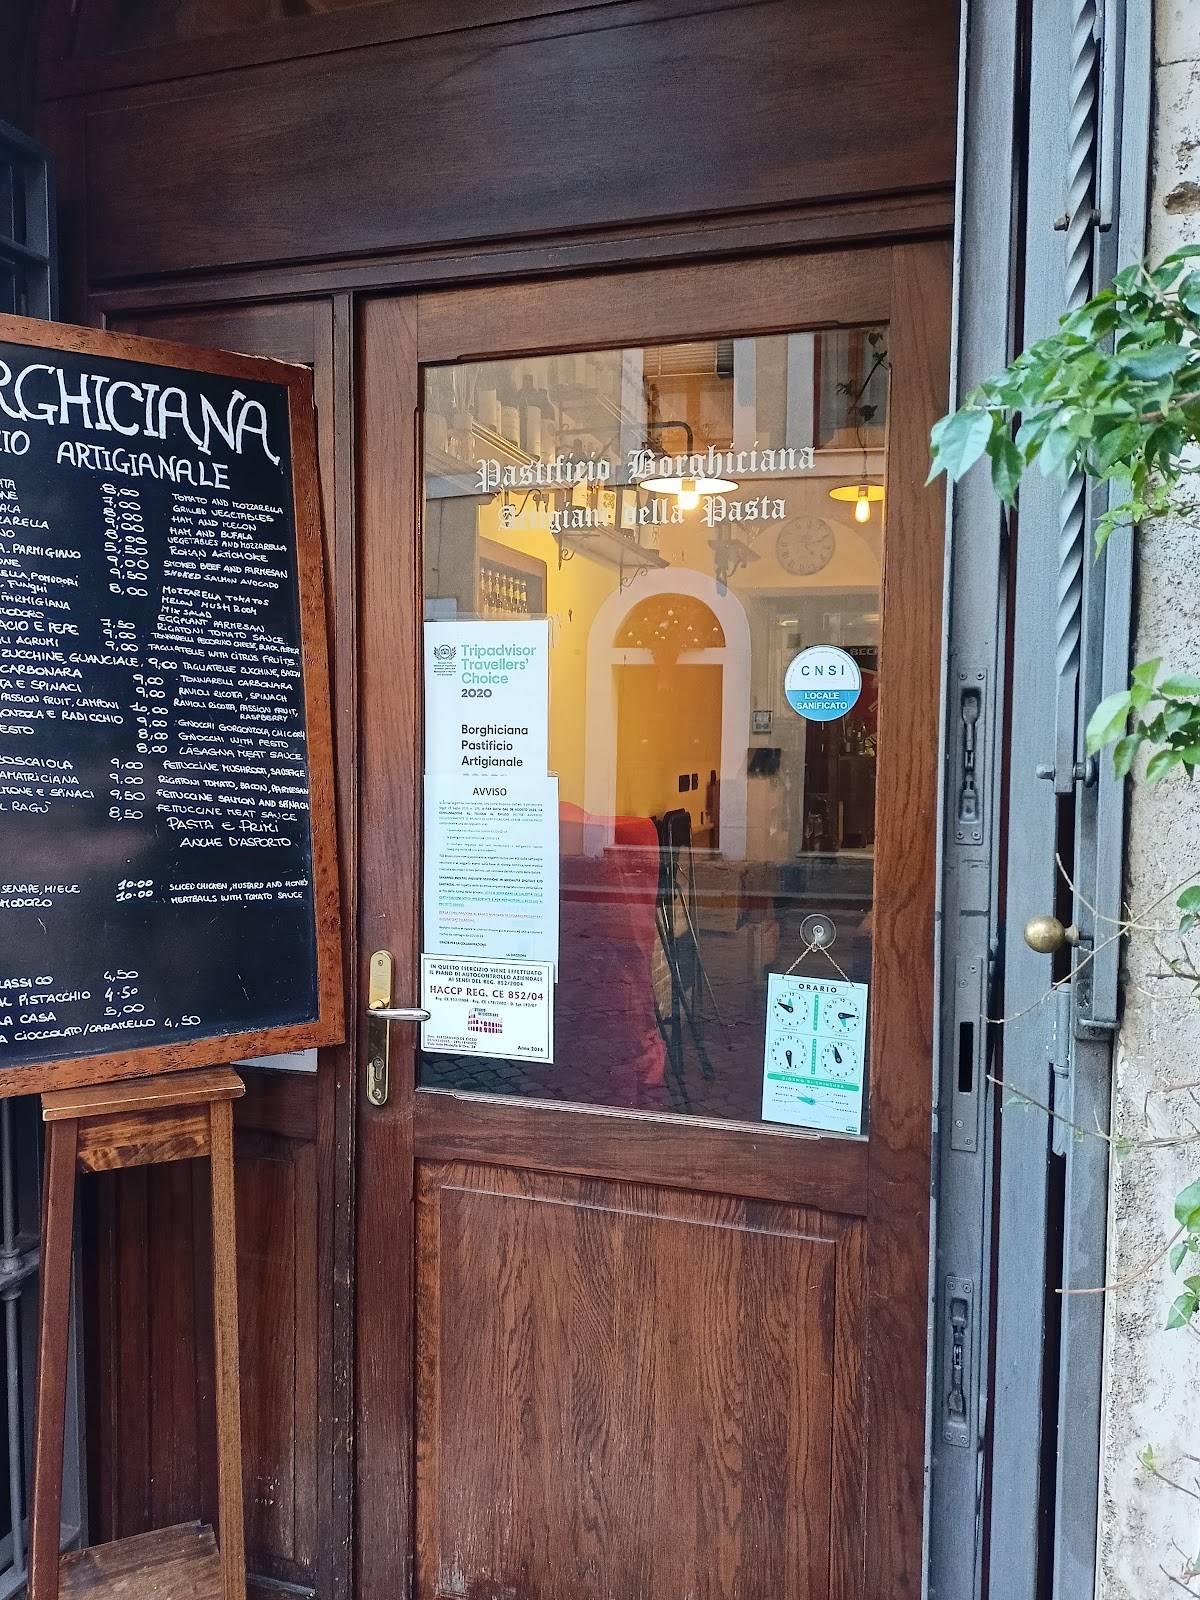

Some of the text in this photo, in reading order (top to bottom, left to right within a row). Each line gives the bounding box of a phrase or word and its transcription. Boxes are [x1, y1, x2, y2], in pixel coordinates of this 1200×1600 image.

[0, 430, 230, 490] IO ARTIGIANALE
[474, 441, 816, 493] Pastificio Borghiciana
[172, 493, 283, 514] TOMATO AND MOZZARELLA
[173, 505, 274, 522] GRILLED VEGETABLES
[702, 495, 787, 528] Pasta
[171, 516, 257, 531] HAM AND MELON
[169, 527, 253, 540] HAM AND BUFALA
[13, 543, 81, 559] PARMIGIANO
[168, 537, 287, 552] VEGETABLES AND MOZZARELLA
[212, 550, 269, 562] ARTICHOKE
[163, 560, 288, 579] SMOKED BEEF AND PARMESAN
[31, 572, 79, 587] POMODORI
[163, 570, 279, 589] SMOKED SALMON AVOCADO
[161, 596, 193, 607] MELON
[162, 585, 270, 607] MOZZARELLA TOMATOS
[161, 605, 212, 620] MIX SALAD
[34, 621, 79, 636] E PEPE
[157, 614, 265, 634] EGGPLANT PARMESAN
[157, 623, 204, 635] RIGATONI
[208, 629, 247, 639] TOMATO
[16, 636, 59, 648] AGRUMI
[1, 649, 67, 665] ZUCCHINE,
[208, 650, 229, 660] WITH
[231, 651, 259, 662] CITRUS
[461, 643, 537, 659] Tripadvisor
[0, 664, 83, 679] CARBONARA
[461, 672, 509, 685] Choice
[16, 680, 82, 693] E SPINACI
[178, 687, 210, 697] RAVIOLI
[237, 679, 293, 691] CARBONARA
[1, 692, 119, 710] PASSION LAMPONI
[461, 688, 493, 699] 2020
[804, 692, 840, 700] LOCALE
[173, 698, 271, 714] RAVIOLI PASSION
[796, 702, 848, 710] SANIFICATO
[46, 710, 124, 725] E RADICCHIO
[178, 719, 215, 730] GNOCCHI
[461, 724, 529, 738] Borghiciana
[178, 732, 289, 748] GNOCCHI WITH PESTO
[461, 740, 513, 751] Pastificio
[178, 746, 304, 761] LASAGNA MEAT SAUCE
[110, 757, 144, 770] 9,00
[461, 755, 524, 769] Artigianale
[0, 770, 80, 785] AMATRICIANA
[109, 773, 144, 785] 9,00
[158, 775, 200, 787] RIGATONI
[36, 788, 95, 799] E SPINACI
[109, 789, 146, 801] 9,50
[155, 789, 214, 802] FETTUCCINE
[217, 795, 256, 806] SALMON
[258, 799, 276, 808] AND
[472, 787, 507, 796] AVVISO
[108, 806, 144, 822] 8,50
[156, 804, 298, 821] FETTUCCINE MEAT SAUCE
[166, 816, 215, 831] PASTA
[238, 818, 279, 833] PRIMI
[179, 836, 292, 848] ANCHE D'ASPORTO
[169, 882, 196, 891] SLICED
[266, 881, 283, 889] AND
[171, 891, 303, 904] MEATBALLS WITH TOMATO SAUCE
[103, 969, 139, 982] 4,50
[430, 985, 544, 1001] HACCP REG. CE 852/04
[798, 983, 837, 993] ORARIO
[18, 991, 91, 1007] PISTACCHIO
[19, 1011, 57, 1024] CASA
[104, 1003, 145, 1017] 5,00
[163, 1014, 202, 1028] 4,50
